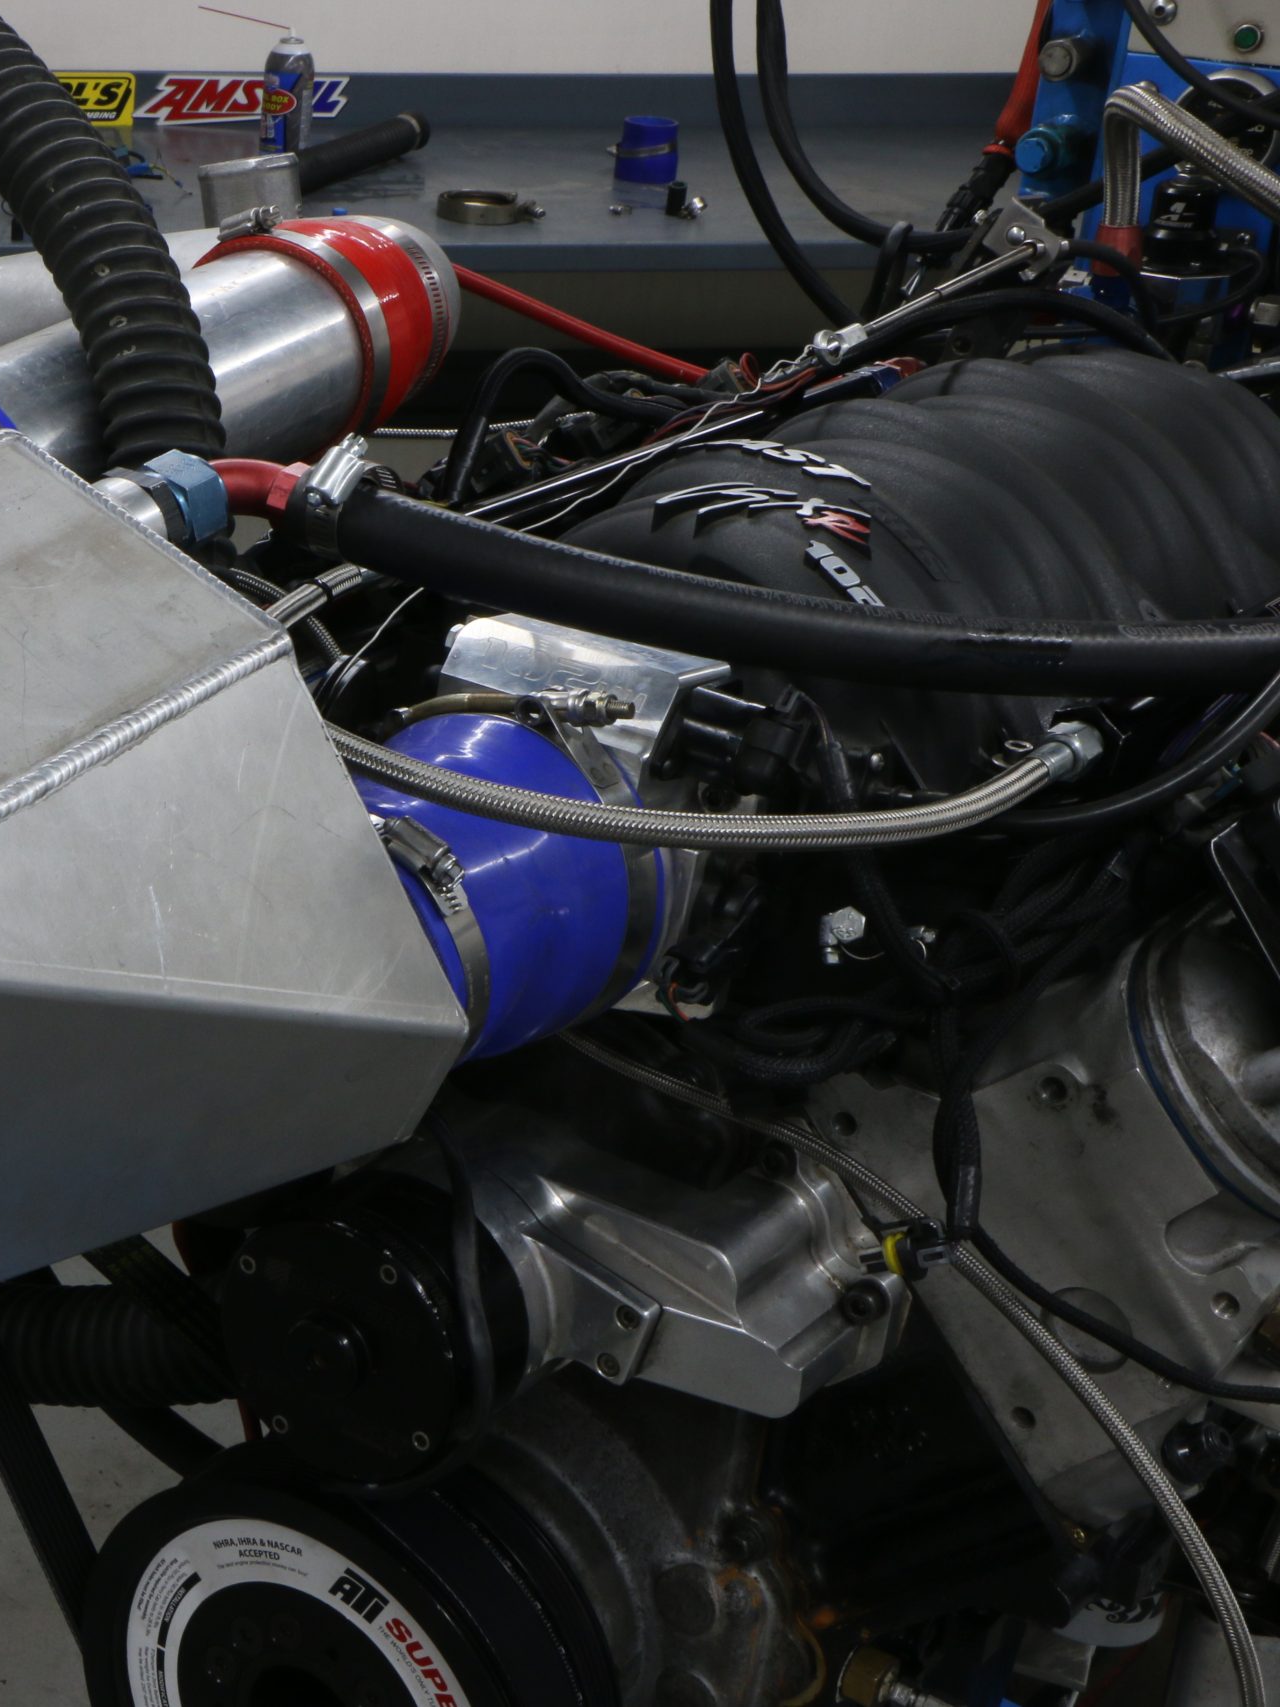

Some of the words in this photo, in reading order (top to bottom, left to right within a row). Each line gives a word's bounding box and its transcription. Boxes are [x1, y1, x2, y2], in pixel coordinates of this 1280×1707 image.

[144, 78, 343, 123] AMSL
[86, 111, 118, 120] MBING
[212, 1537, 238, 1550] NHRA,
[238, 1536, 258, 1547] IHRA
[259, 1538, 266, 1547] &
[267, 1539, 303, 1557] NASCAR
[238, 1548, 281, 1561] ACCEPTED
[377, 1625, 391, 1641] THE
